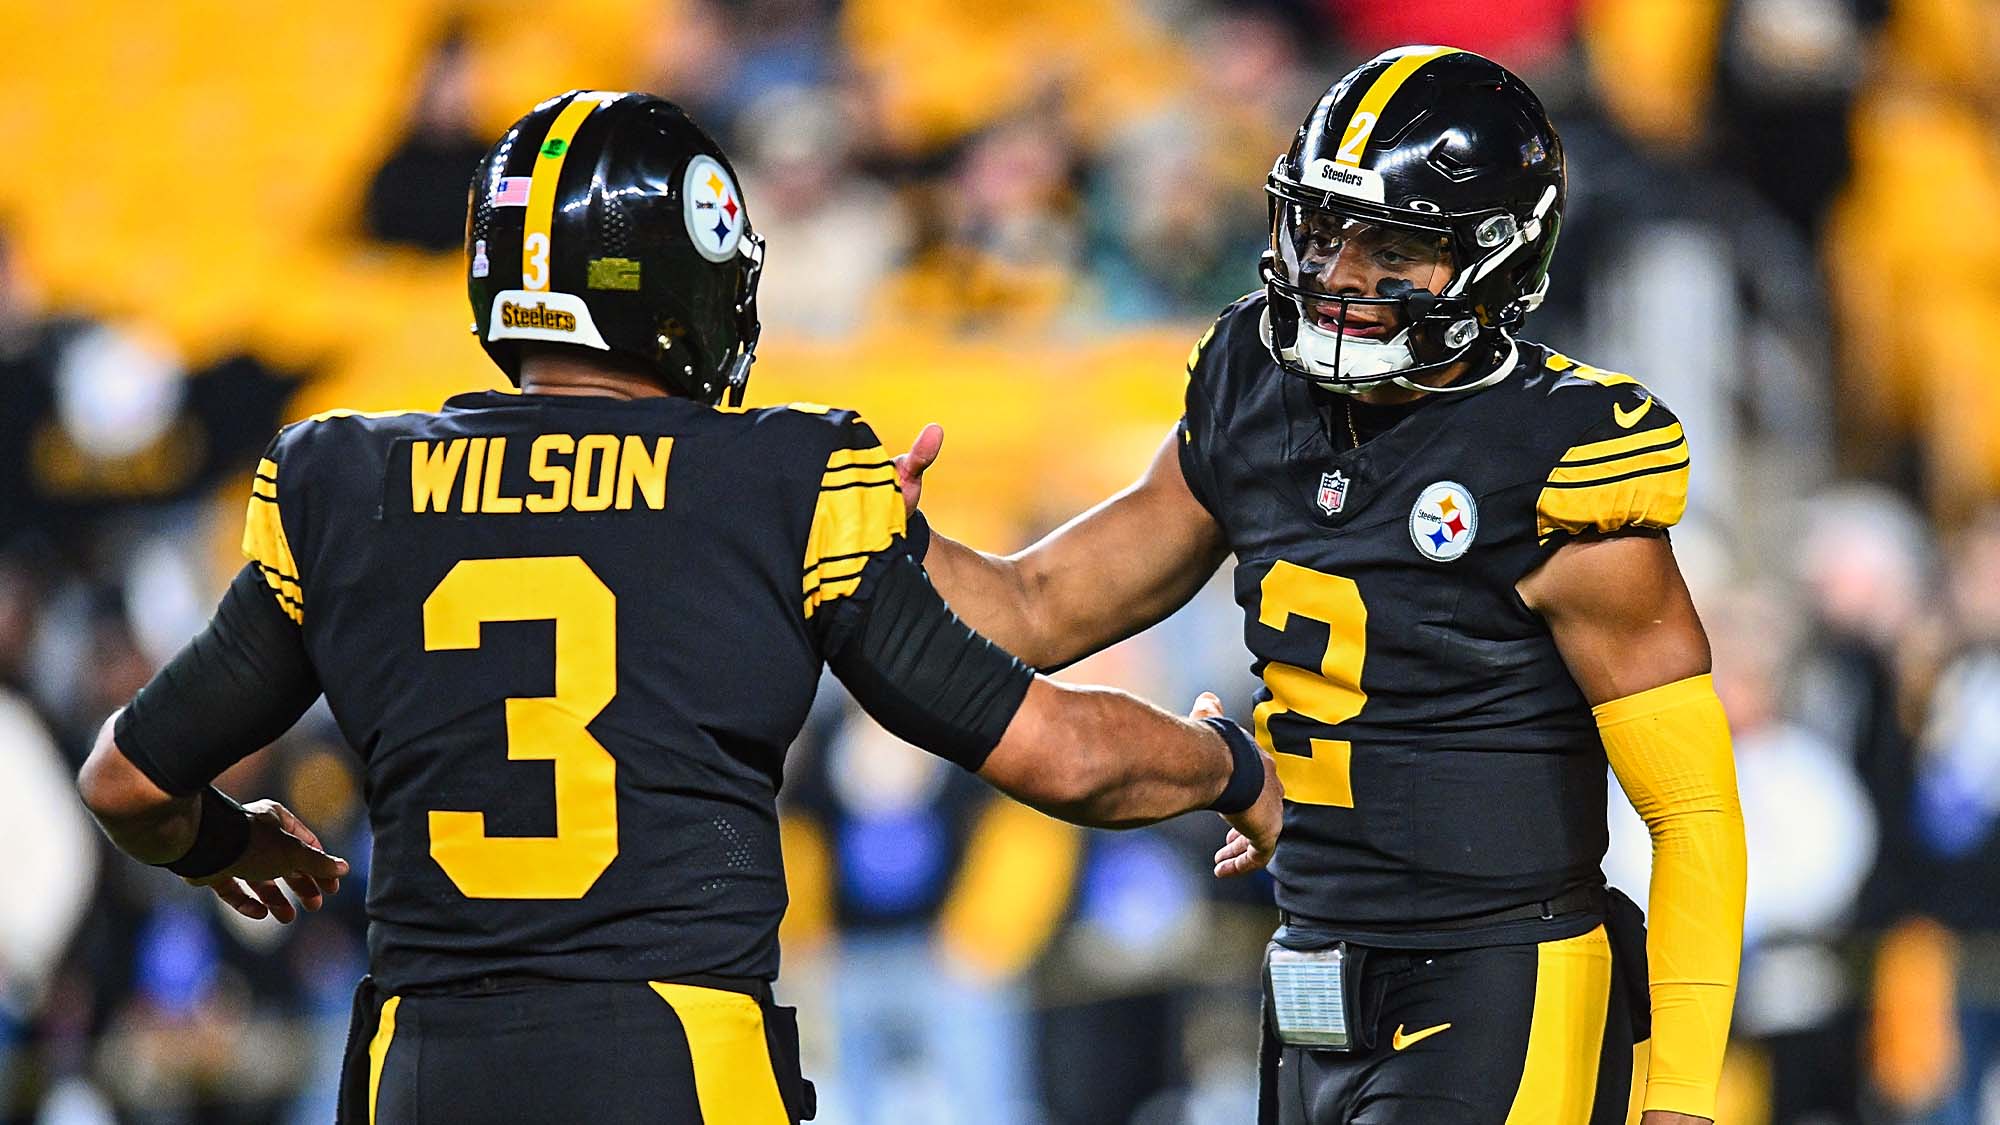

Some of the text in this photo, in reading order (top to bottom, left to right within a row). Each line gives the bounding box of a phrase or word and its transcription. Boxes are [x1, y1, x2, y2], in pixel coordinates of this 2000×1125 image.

[1335, 111, 1377, 163] 2
[1321, 164, 1363, 187] Steelers
[523, 232, 550, 290] 3
[502, 302, 577, 332] Steelers
[411, 434, 674, 513] WILSON
[1321, 489, 1341, 508] NFL
[1417, 508, 1442, 524] Steelers
[1253, 560, 1367, 808] 2
[423, 555, 619, 898] 3
